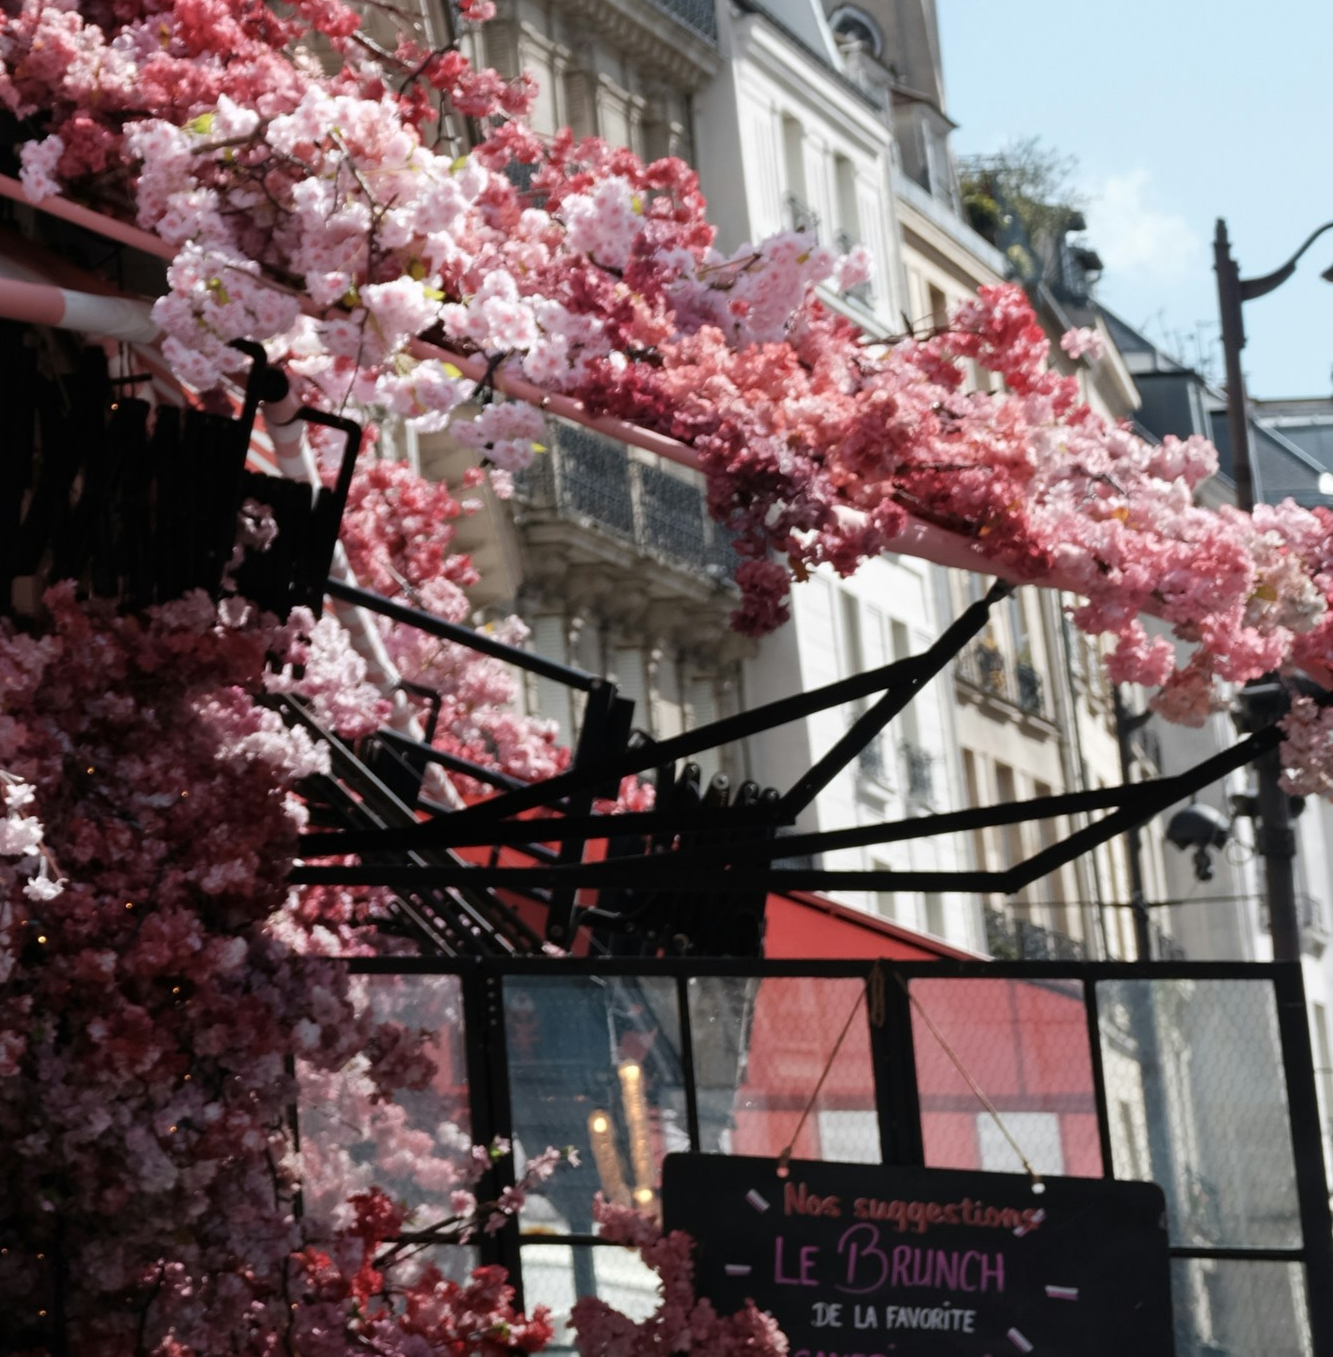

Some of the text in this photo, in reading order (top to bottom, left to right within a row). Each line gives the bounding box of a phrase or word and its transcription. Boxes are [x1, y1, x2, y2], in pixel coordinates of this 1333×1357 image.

[783, 1181, 1046, 1234] Nos suggestions
[774, 1222, 1006, 1295] LE BRUNCH
[810, 1300, 844, 1328] DE
[853, 1303, 879, 1330] LA
